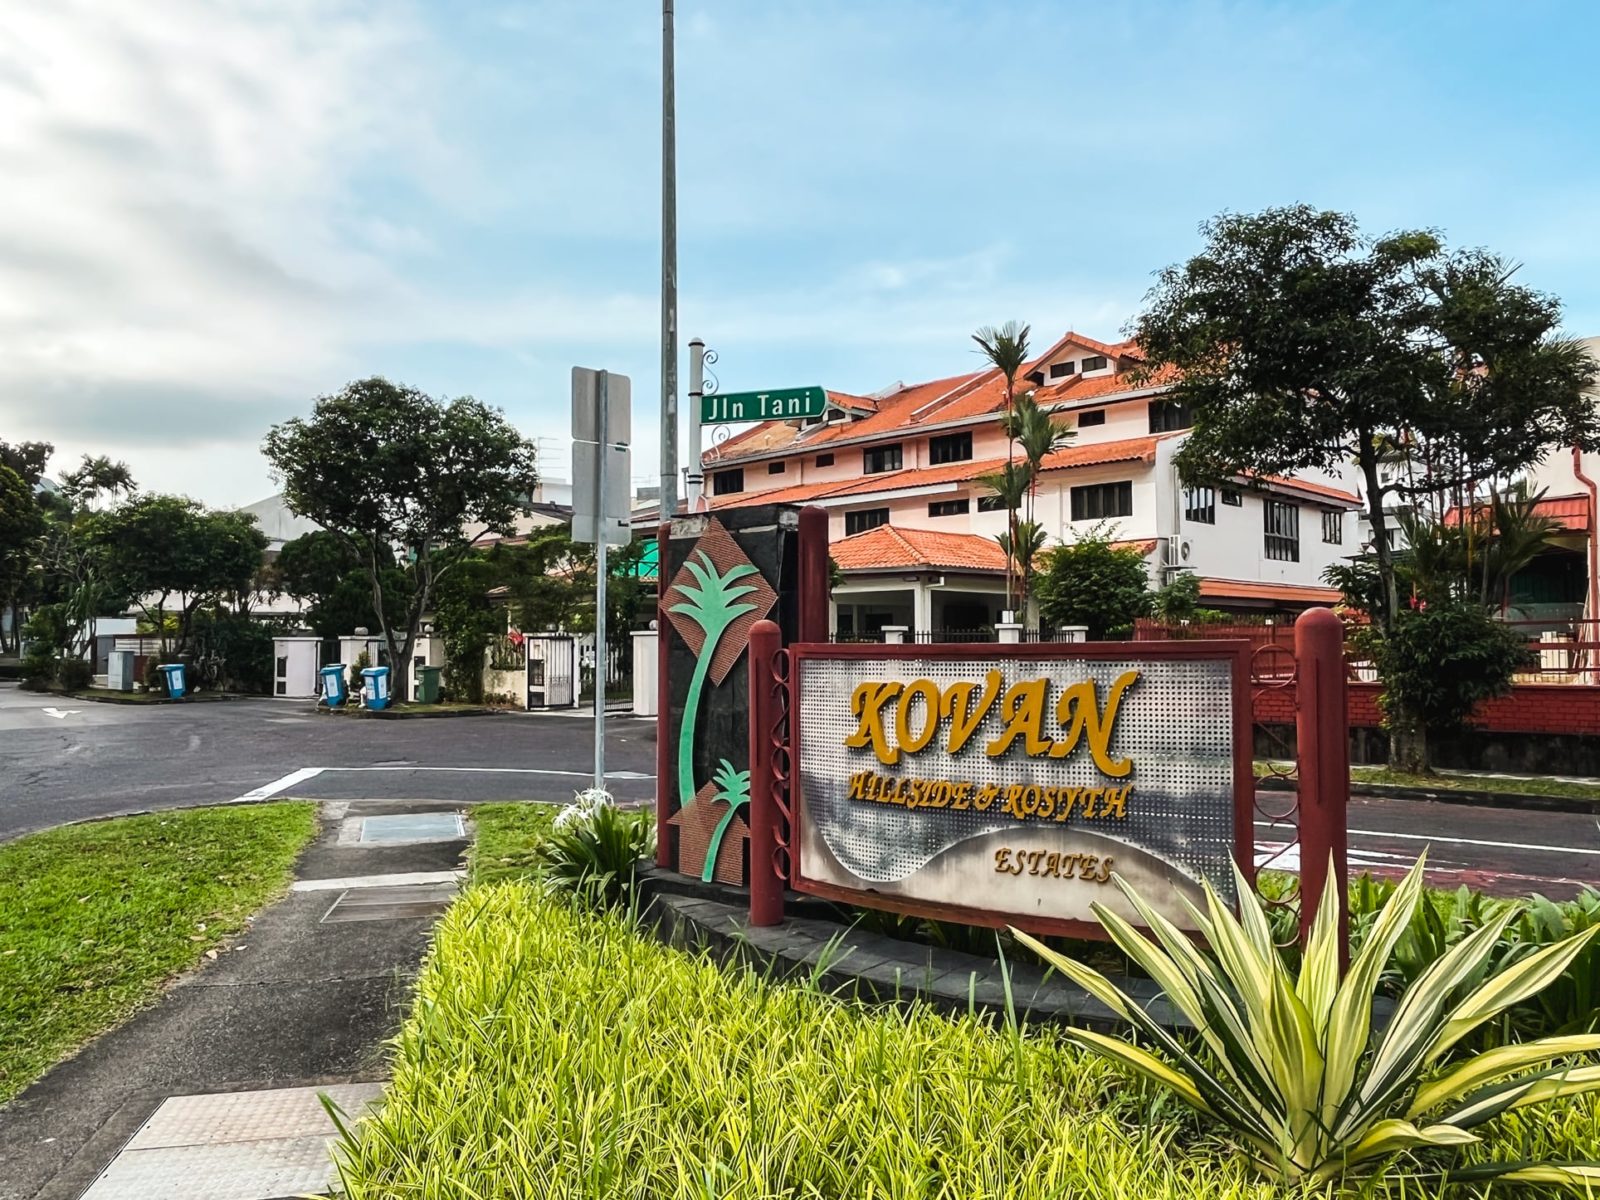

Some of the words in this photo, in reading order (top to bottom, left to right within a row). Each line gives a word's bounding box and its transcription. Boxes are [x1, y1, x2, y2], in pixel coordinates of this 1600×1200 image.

[708, 398, 744, 420] Jln
[757, 391, 810, 416] Tani
[845, 669, 1140, 777] KOVAN
[848, 771, 970, 811] HILLSIDE
[974, 785, 998, 808] &
[1004, 784, 1133, 822] ROSYTH
[994, 848, 1114, 883] ESTATES
